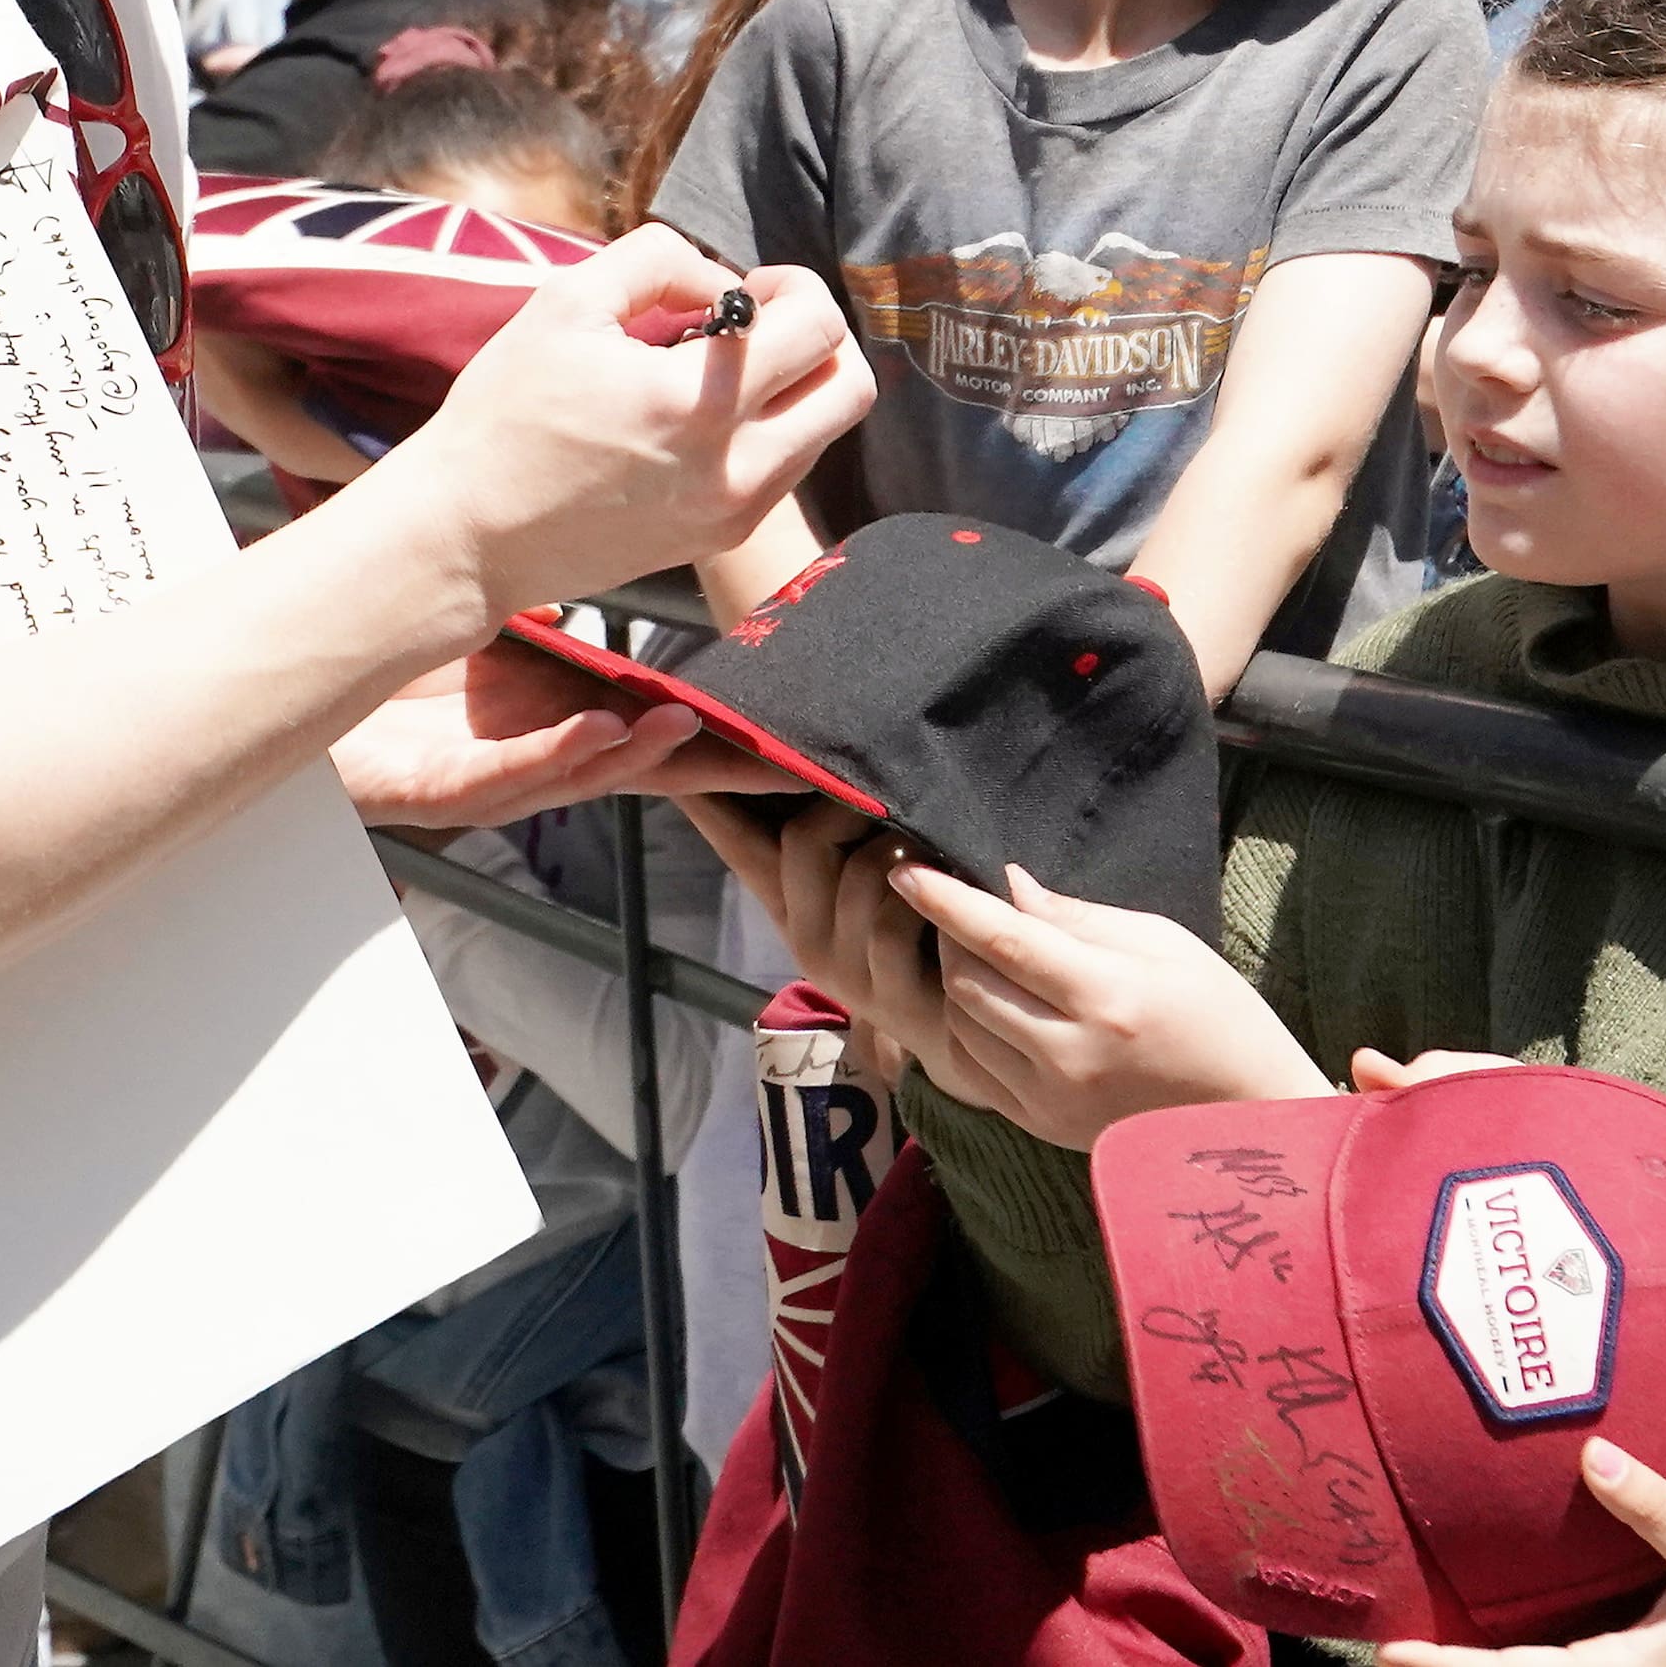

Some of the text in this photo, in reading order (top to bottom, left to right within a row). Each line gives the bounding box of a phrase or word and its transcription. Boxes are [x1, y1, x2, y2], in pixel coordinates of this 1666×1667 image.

[928, 310, 1205, 391] HARLEY-DAVIDSON
[955, 372, 1163, 405] MOTOR COMPANY INC.
[72, 493, 85, 517] on
[1485, 1187, 1557, 1393] VICTOIRE
